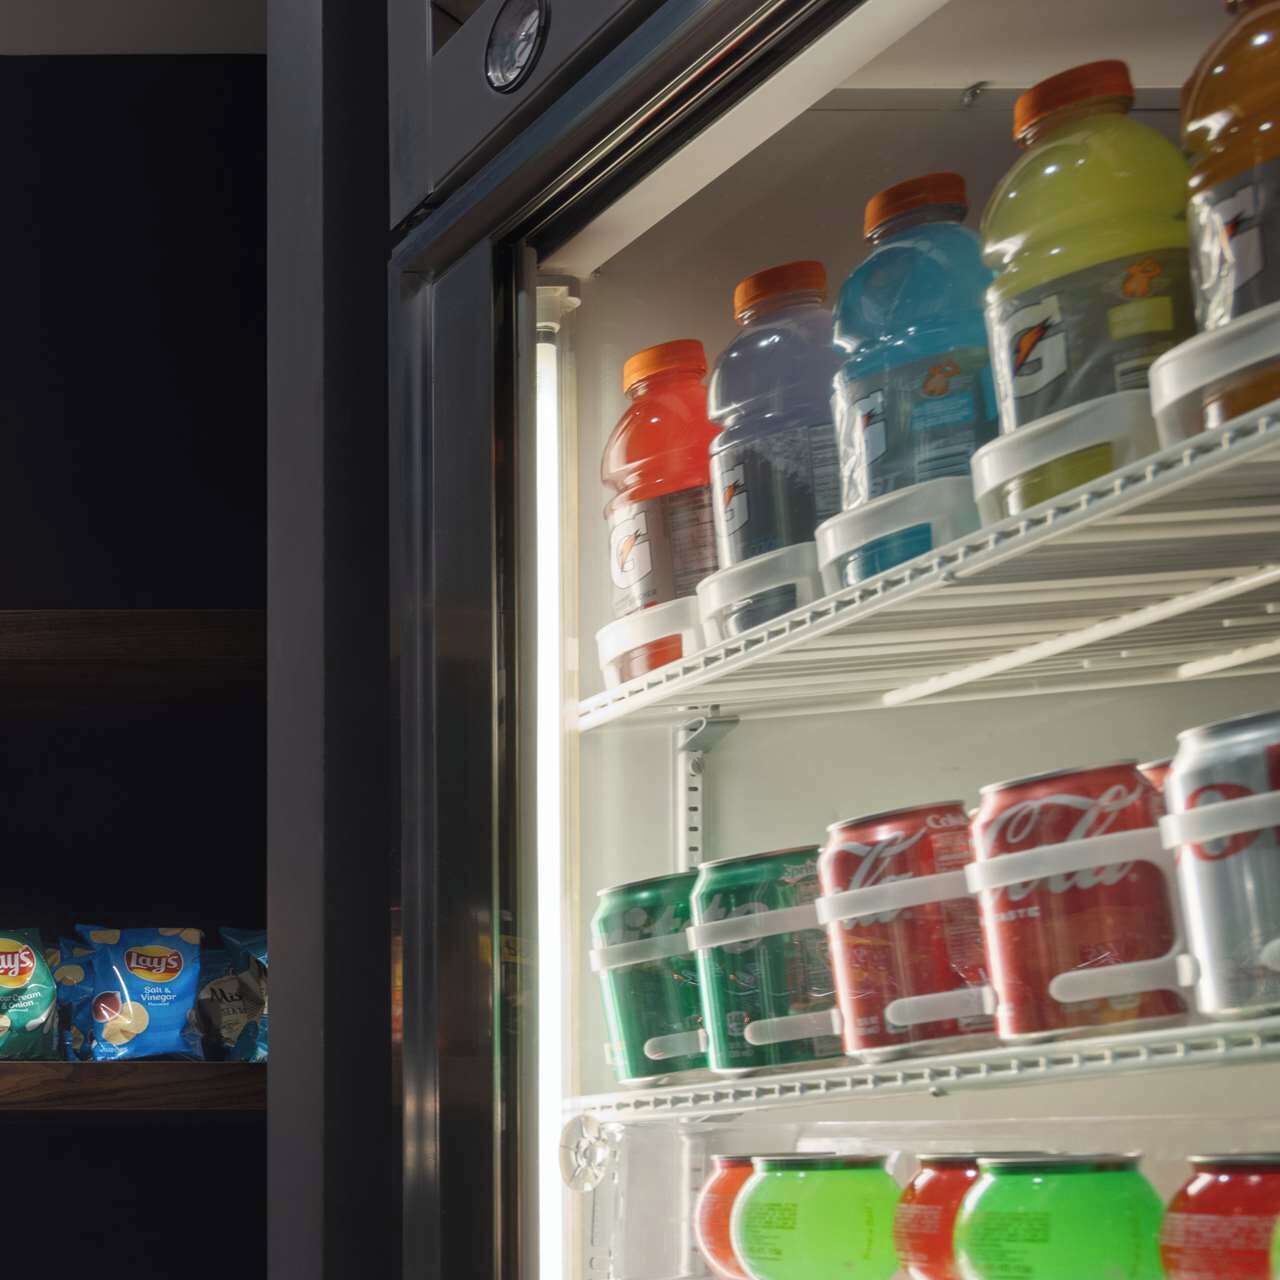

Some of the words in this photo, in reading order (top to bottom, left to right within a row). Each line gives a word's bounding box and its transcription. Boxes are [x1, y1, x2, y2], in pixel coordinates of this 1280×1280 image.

[611, 511, 653, 589] G
[127, 950, 180, 975] Lay's
[140, 993, 178, 1004] Vinegar
